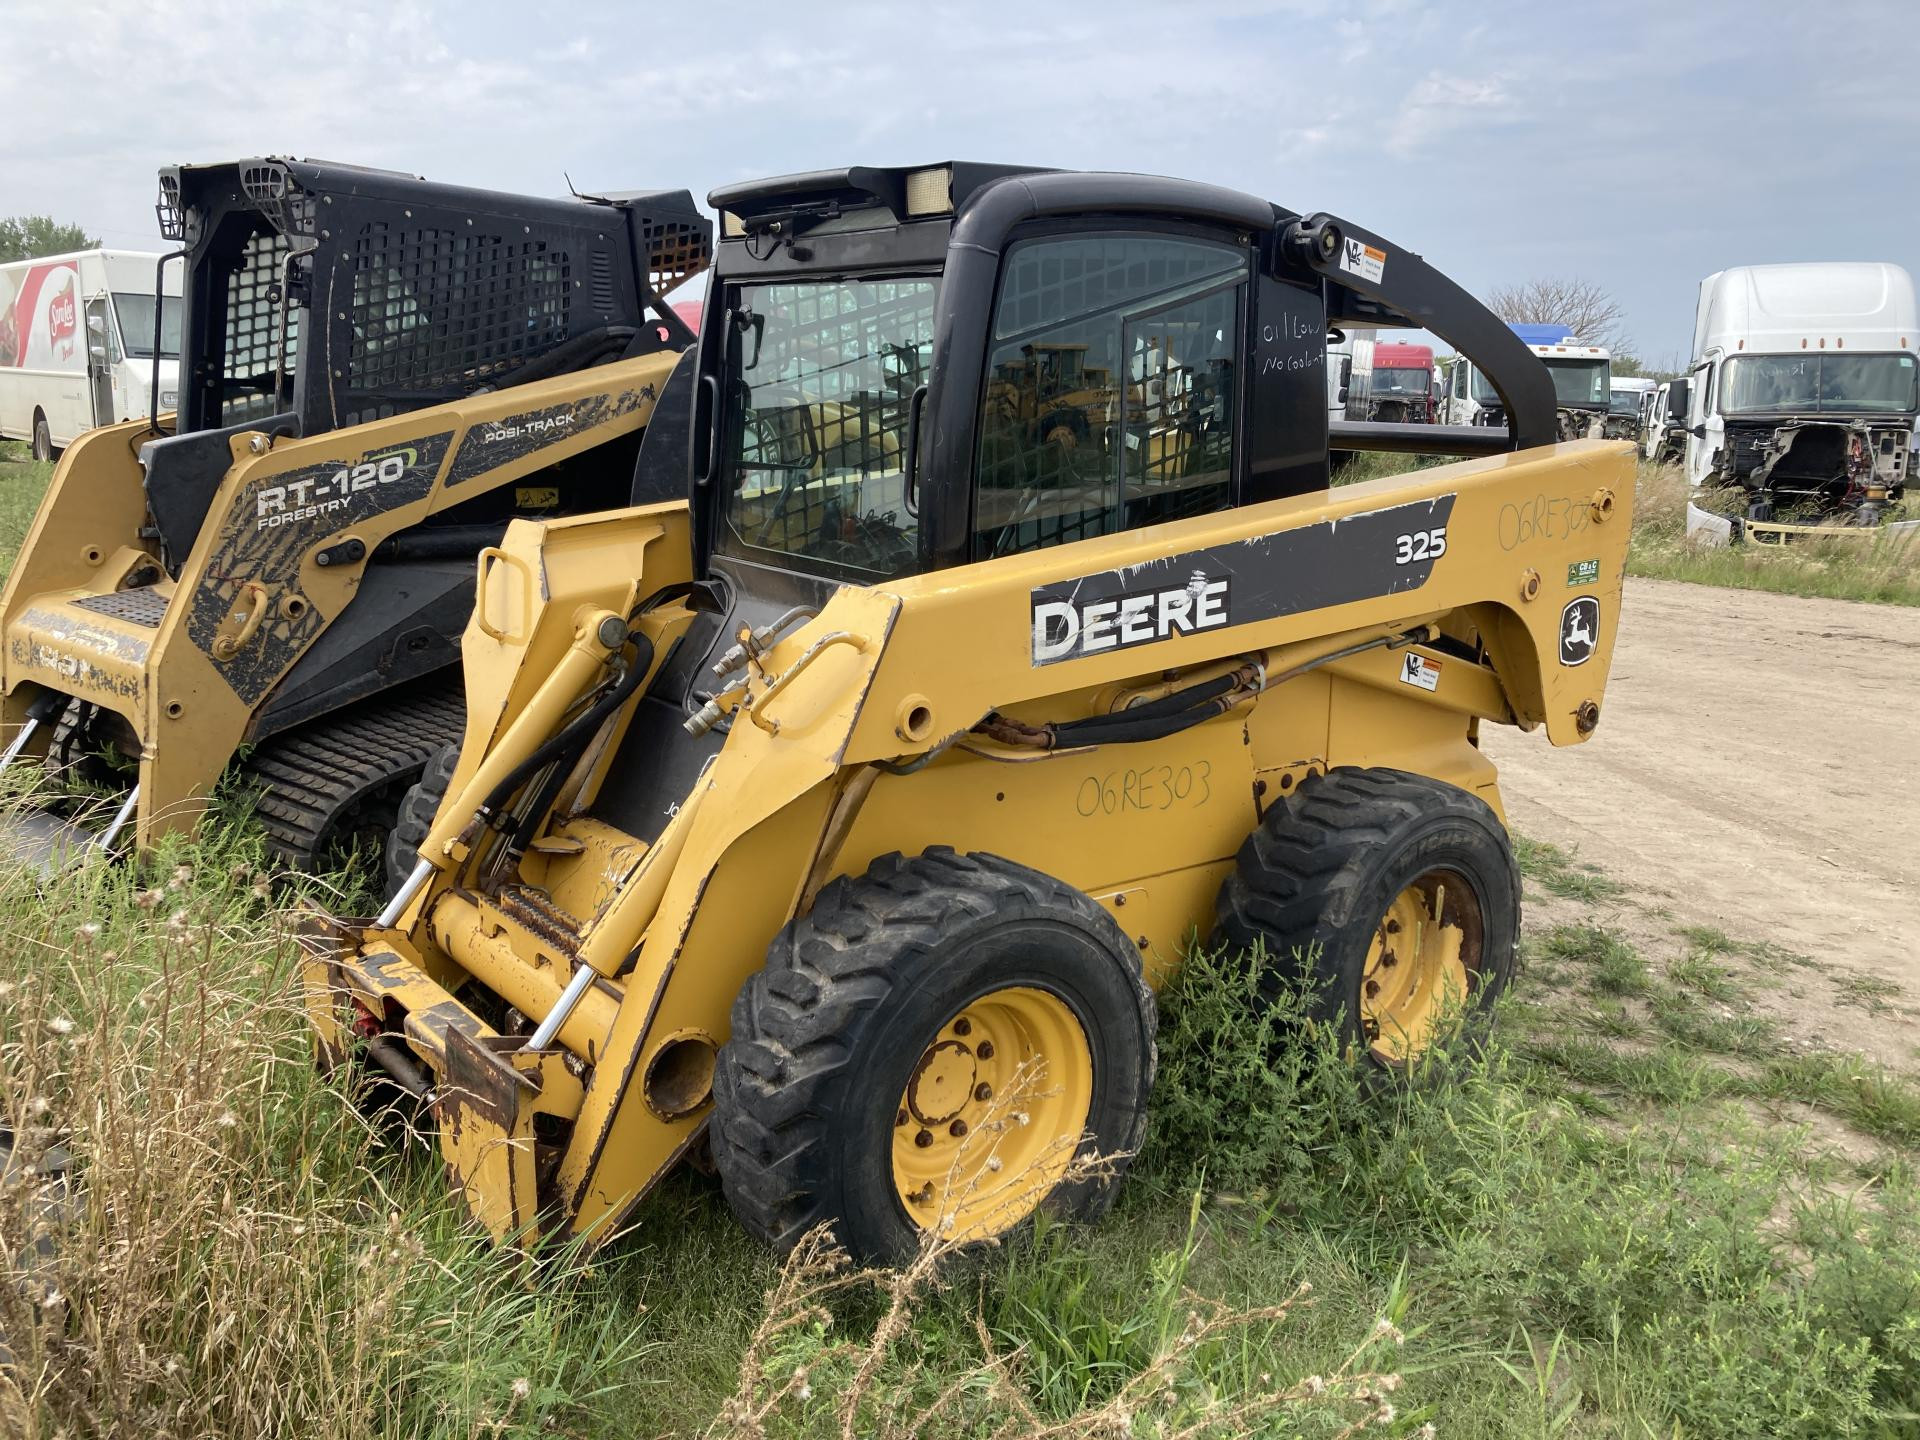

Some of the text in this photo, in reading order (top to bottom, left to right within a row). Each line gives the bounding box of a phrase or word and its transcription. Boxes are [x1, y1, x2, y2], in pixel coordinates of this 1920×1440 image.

[64, 299, 75, 327] Lee
[1262, 356, 1284, 376] No
[484, 413, 576, 444] POSI-TRACK
[257, 456, 405, 517] RT-120
[257, 496, 352, 532] FORESTRY
[1395, 527, 1447, 565] 325
[1034, 580, 1229, 661] DEERE
[1076, 760, 1212, 817] 06RE303
[663, 801, 680, 818] JO
